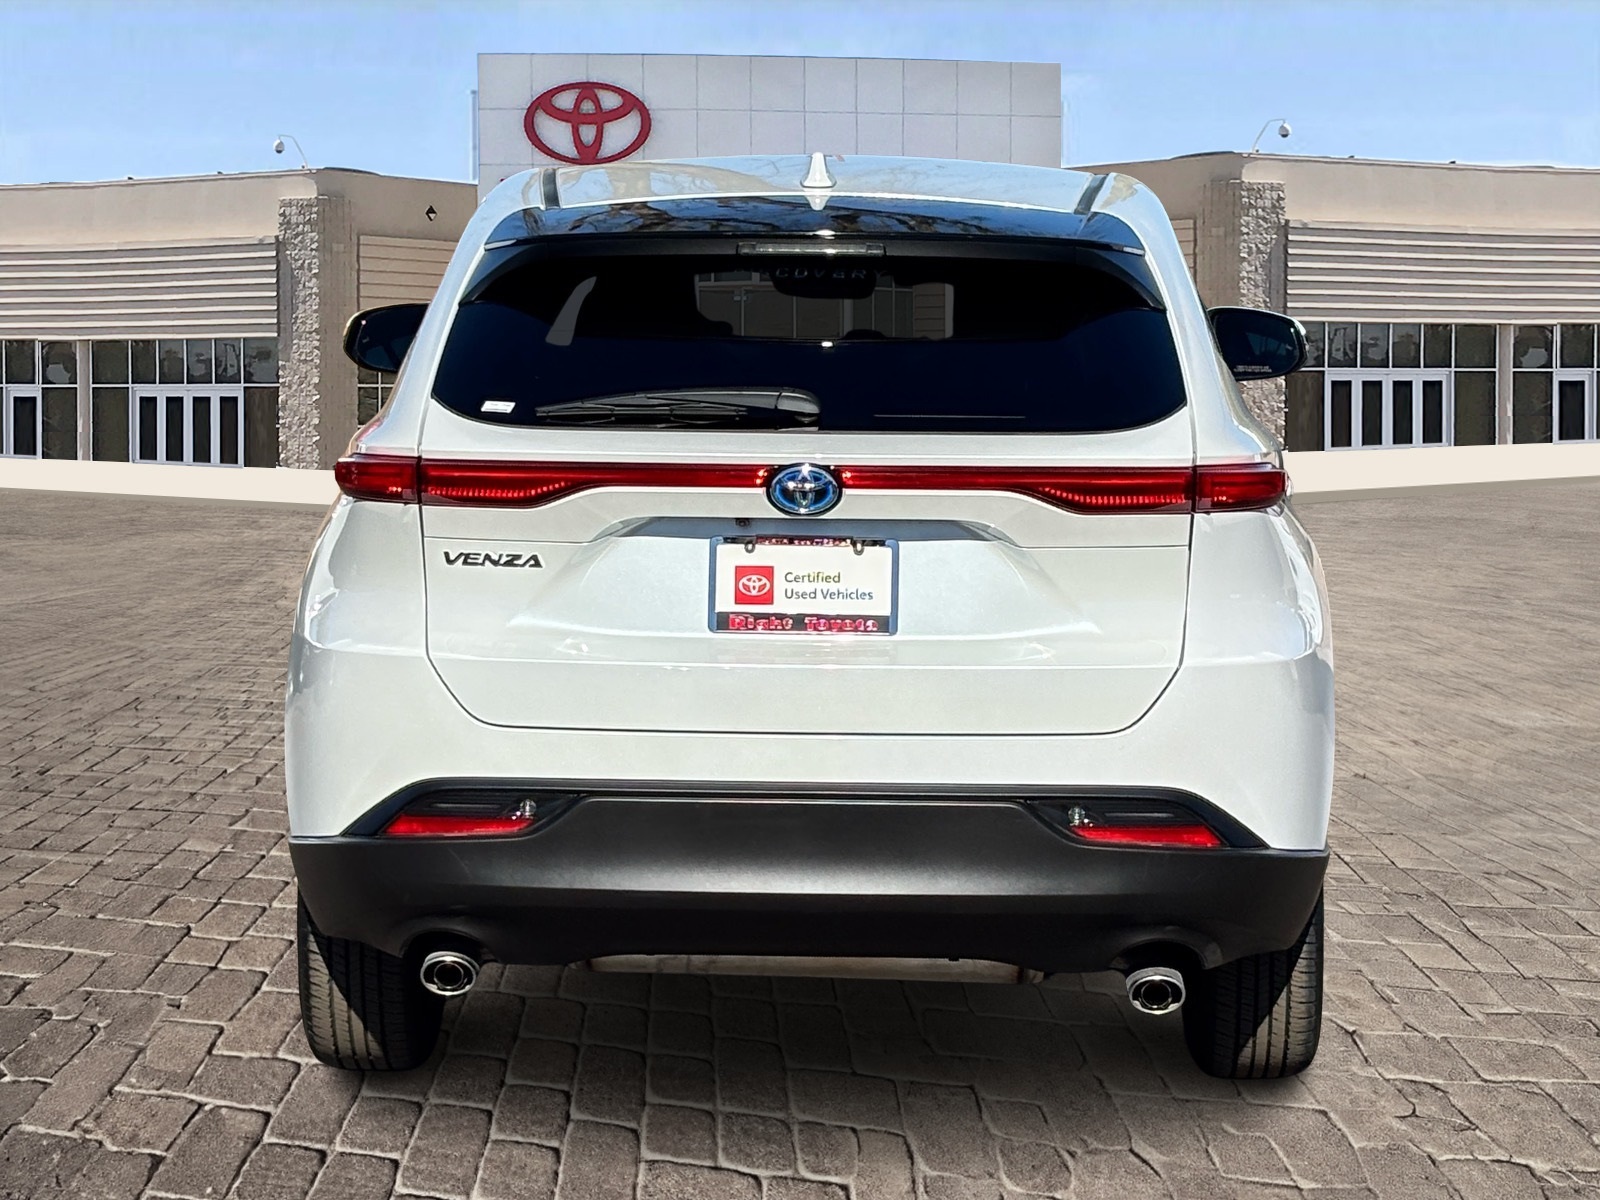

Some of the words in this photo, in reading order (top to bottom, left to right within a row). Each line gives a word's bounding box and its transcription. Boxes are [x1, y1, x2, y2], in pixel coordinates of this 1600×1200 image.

[443, 551, 543, 568] VENZA
[784, 571, 841, 584] Certified
[784, 588, 817, 600] Used
[821, 588, 874, 601] Vehicles
[804, 616, 879, 631] Toyota
